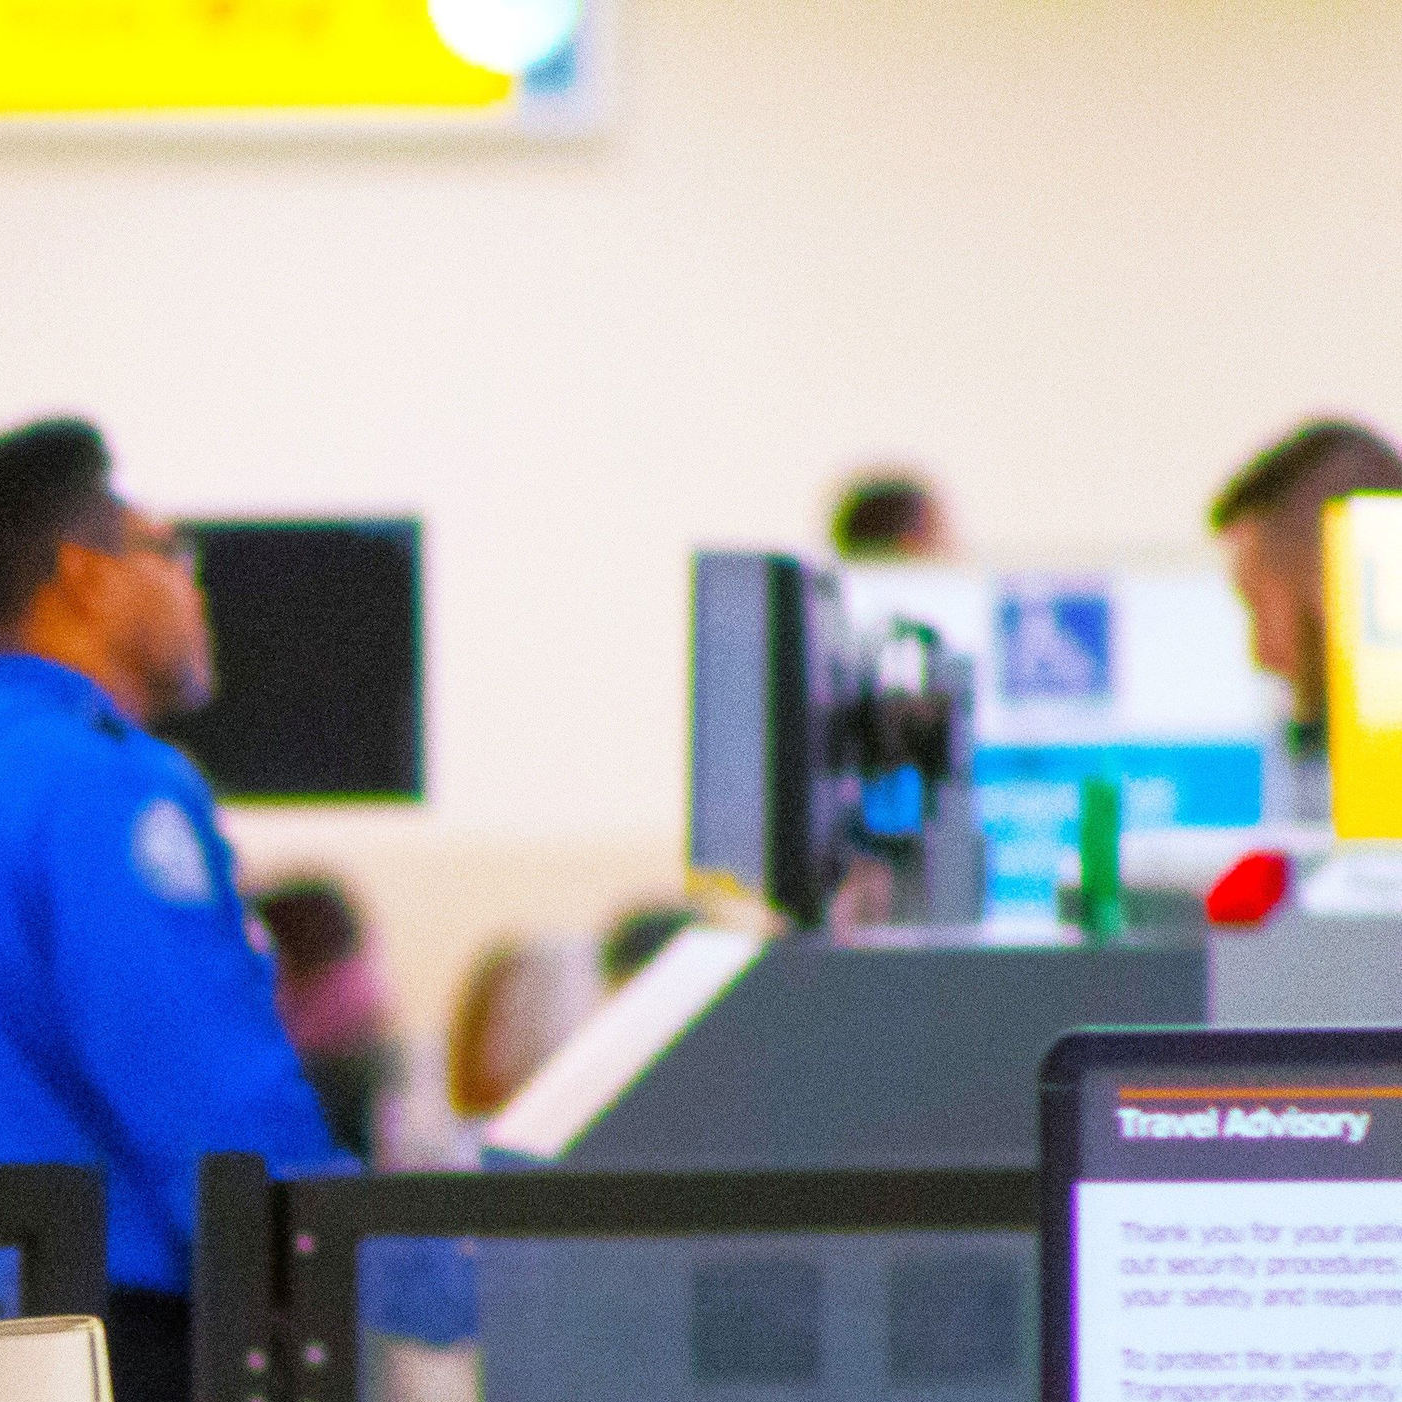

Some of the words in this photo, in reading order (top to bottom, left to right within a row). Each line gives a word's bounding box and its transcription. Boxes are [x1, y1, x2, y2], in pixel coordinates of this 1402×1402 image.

[1115, 1105, 1220, 1139] Travel
[1223, 1105, 1372, 1144] Advisory
[1120, 1222, 1190, 1245] Thank
[1200, 1225, 1243, 1245] you
[1250, 1222, 1282, 1245] for
[1293, 1225, 1344, 1245] your
[1166, 1256, 1257, 1278] security
[1120, 1289, 1172, 1309] your
[1182, 1286, 1252, 1309] safety
[1263, 1286, 1306, 1309] and
[1120, 1348, 1146, 1373] To
[1153, 1350, 1239, 1373] protect
[1245, 1349, 1284, 1373] the
[1291, 1348, 1363, 1373] safety
[1370, 1348, 1396, 1373] of
[1120, 1380, 1295, 1402] Transportation
[1302, 1380, 1395, 1402] Security
